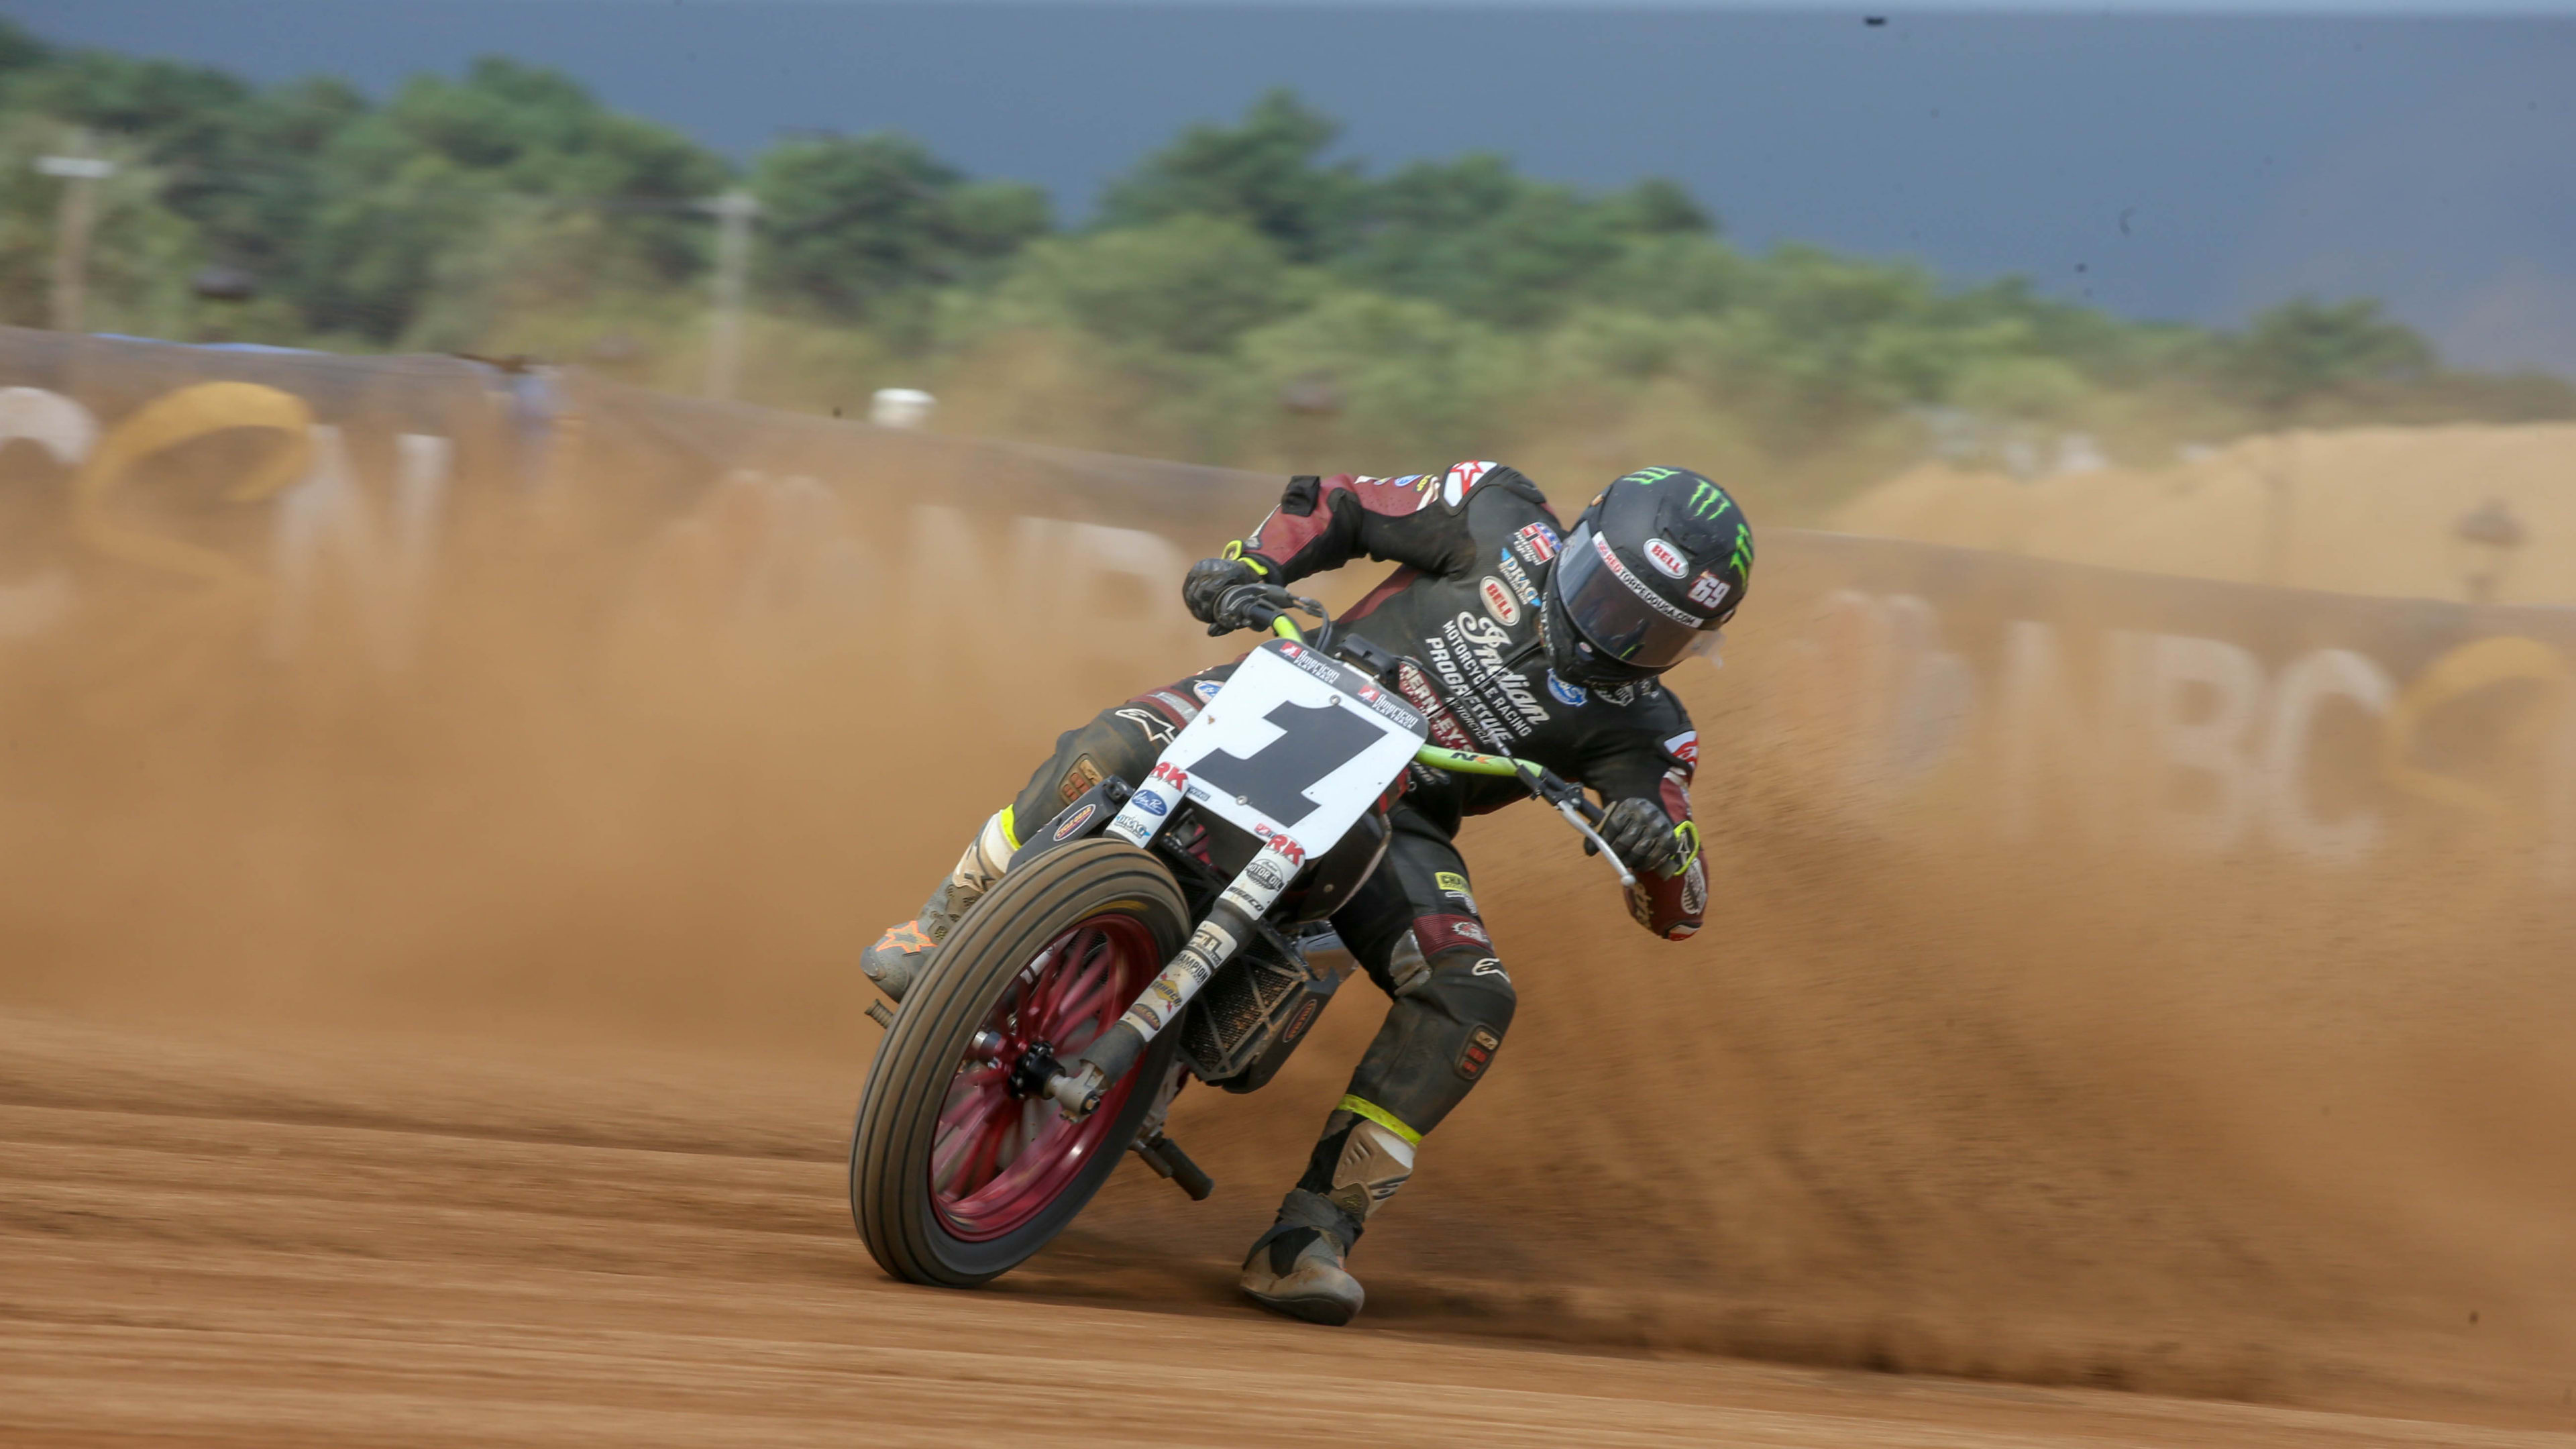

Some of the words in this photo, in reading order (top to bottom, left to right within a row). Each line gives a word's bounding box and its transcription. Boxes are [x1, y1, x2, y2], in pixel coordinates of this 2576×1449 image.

[1650, 544, 1680, 574] BELL
[1497, 555, 1538, 601] DRAG
[1689, 574, 1731, 608] 69
[1485, 582, 1514, 620] BELL
[1297, 649, 1341, 681] American
[1442, 619, 1499, 699] MOTORCYCLE
[1491, 696, 1533, 737] RACING
[1456, 611, 1551, 725] Indian
[1376, 693, 1419, 729] American
[1150, 761, 1189, 792] RK
[1185, 700, 1389, 828] 1
[1118, 815, 1148, 837] DRAG
[1266, 833, 1305, 867] RK
[1176, 953, 1209, 984] HAMPION
